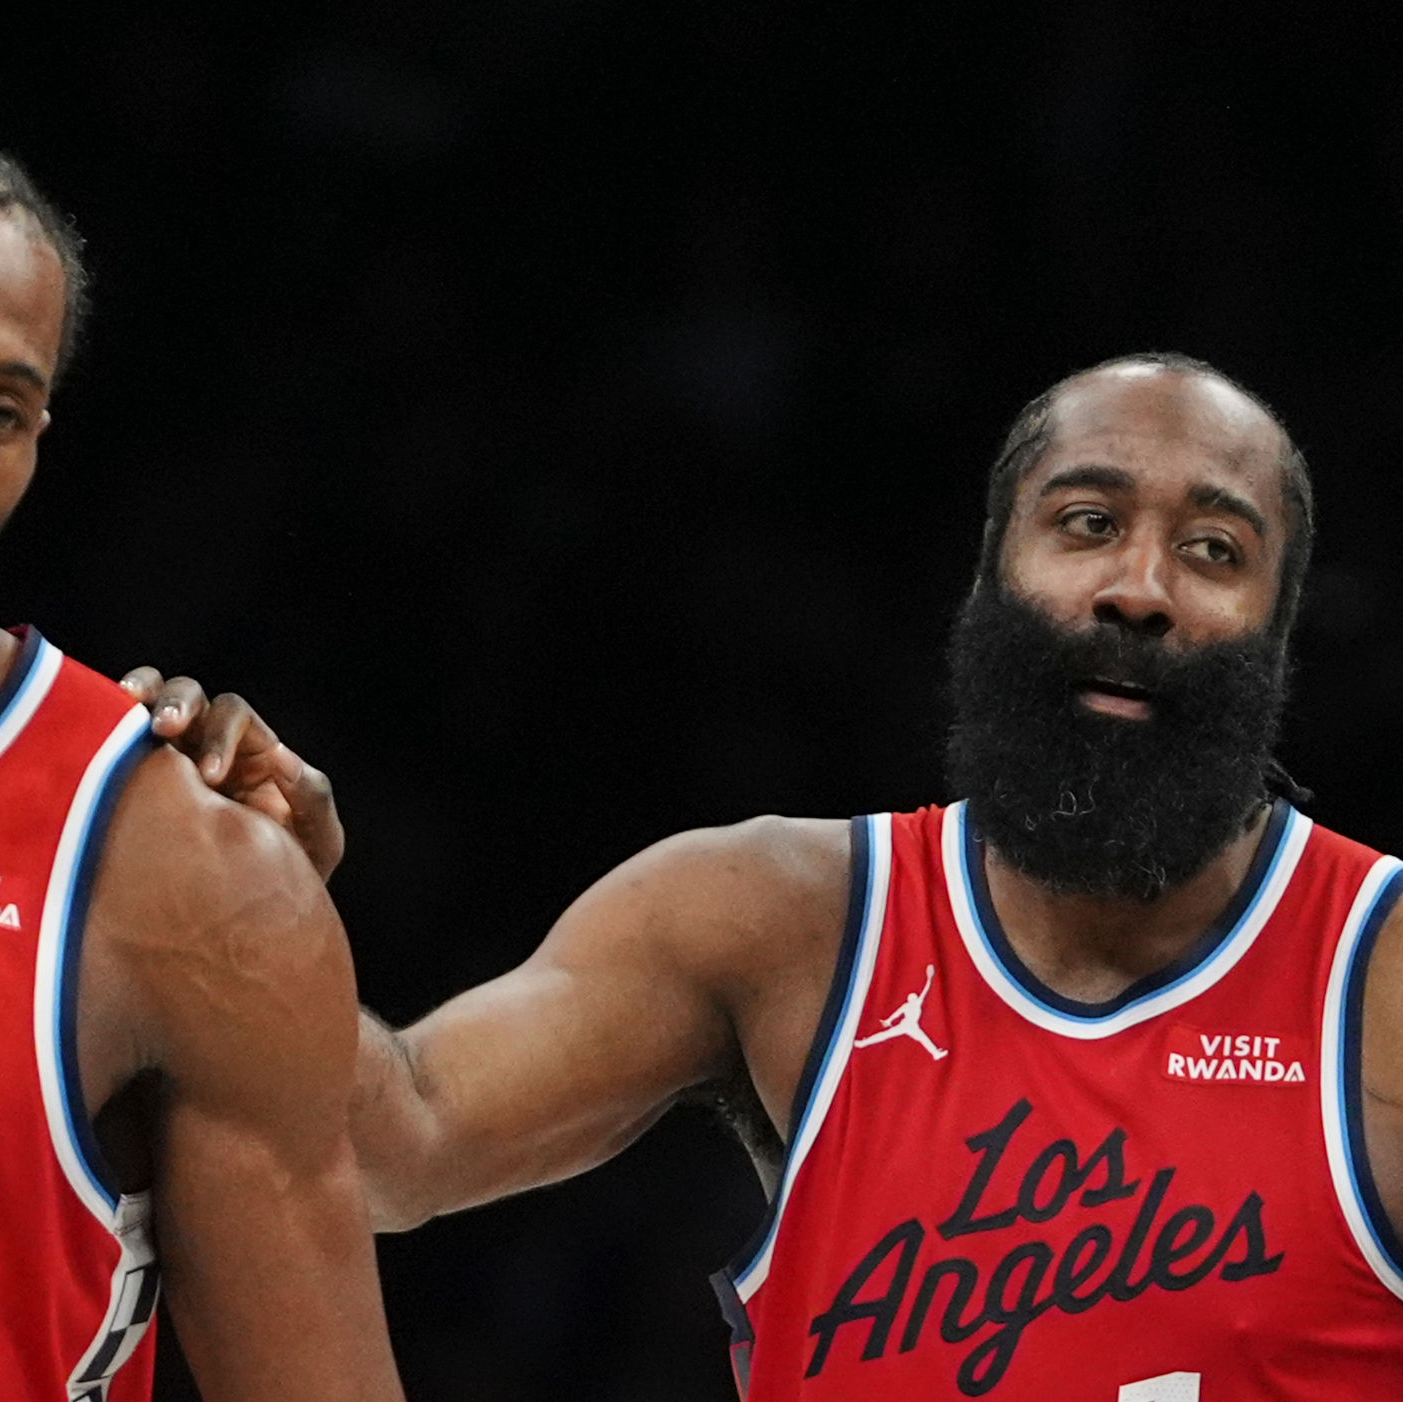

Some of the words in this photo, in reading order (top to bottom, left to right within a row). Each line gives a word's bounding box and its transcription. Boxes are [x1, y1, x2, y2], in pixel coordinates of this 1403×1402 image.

[1167, 1052, 1306, 1082] RWANDA
[1200, 1034, 1281, 1058] VISIT
[937, 1097, 1141, 1241] Los
[803, 1167, 1286, 1398] Angeles
